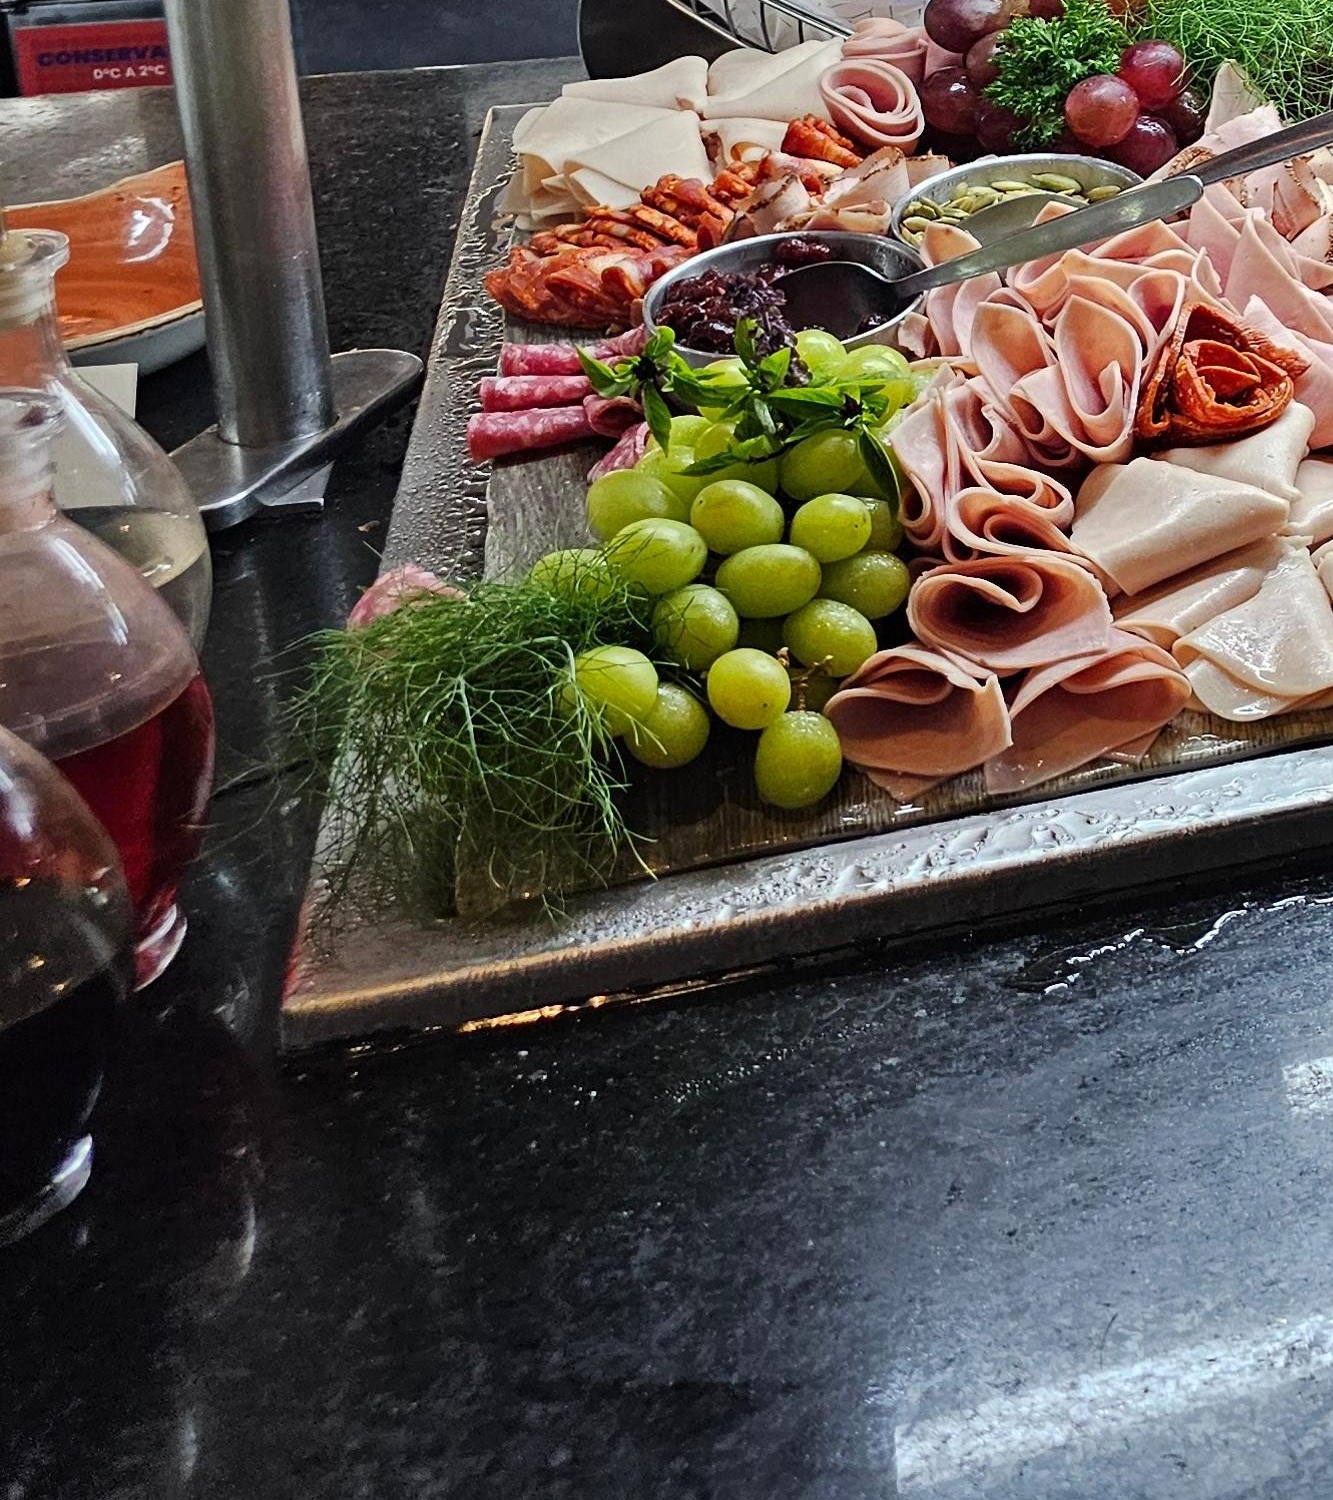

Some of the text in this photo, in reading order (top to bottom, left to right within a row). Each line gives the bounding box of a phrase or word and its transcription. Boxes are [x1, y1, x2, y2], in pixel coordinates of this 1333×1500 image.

[38, 46, 168, 66] CONSERVA
[93, 64, 167, 80] 0°C A 2°C
